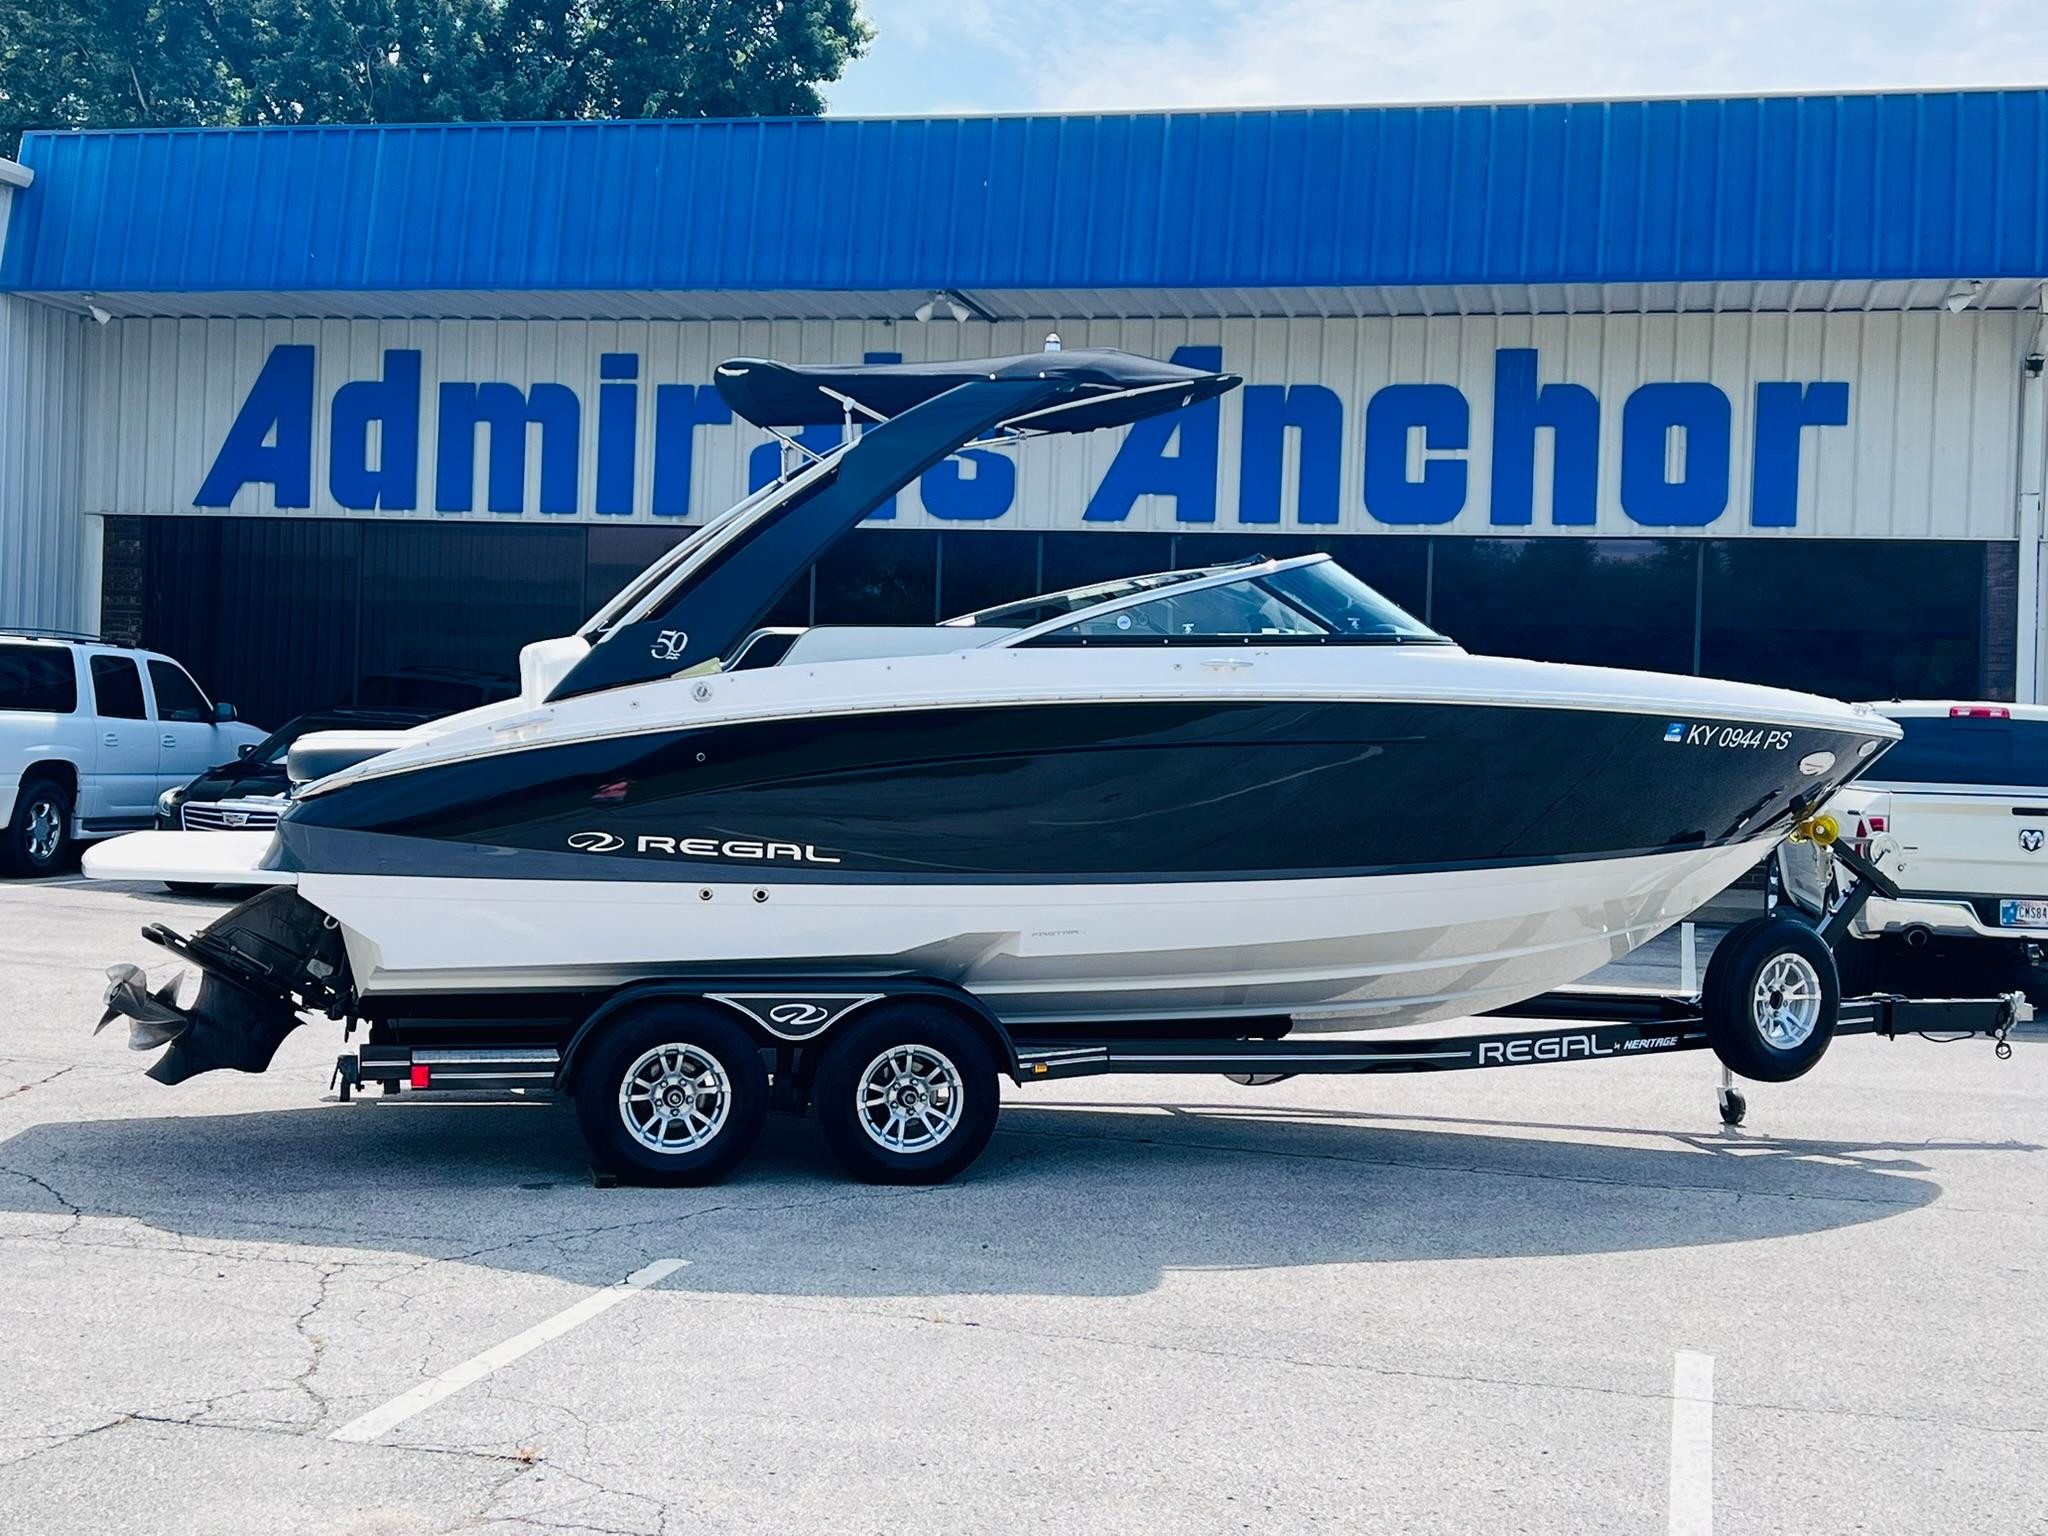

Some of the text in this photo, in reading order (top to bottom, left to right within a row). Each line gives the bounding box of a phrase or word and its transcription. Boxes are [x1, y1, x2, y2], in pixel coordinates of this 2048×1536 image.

[193, 344, 1849, 527] Admirs Anchor
[1686, 724, 1793, 750] KY 0944 PS
[637, 835, 841, 863] REGAL
[1478, 1034, 1614, 1065] REGAL
[1623, 1036, 1679, 1051] HERITAGE
